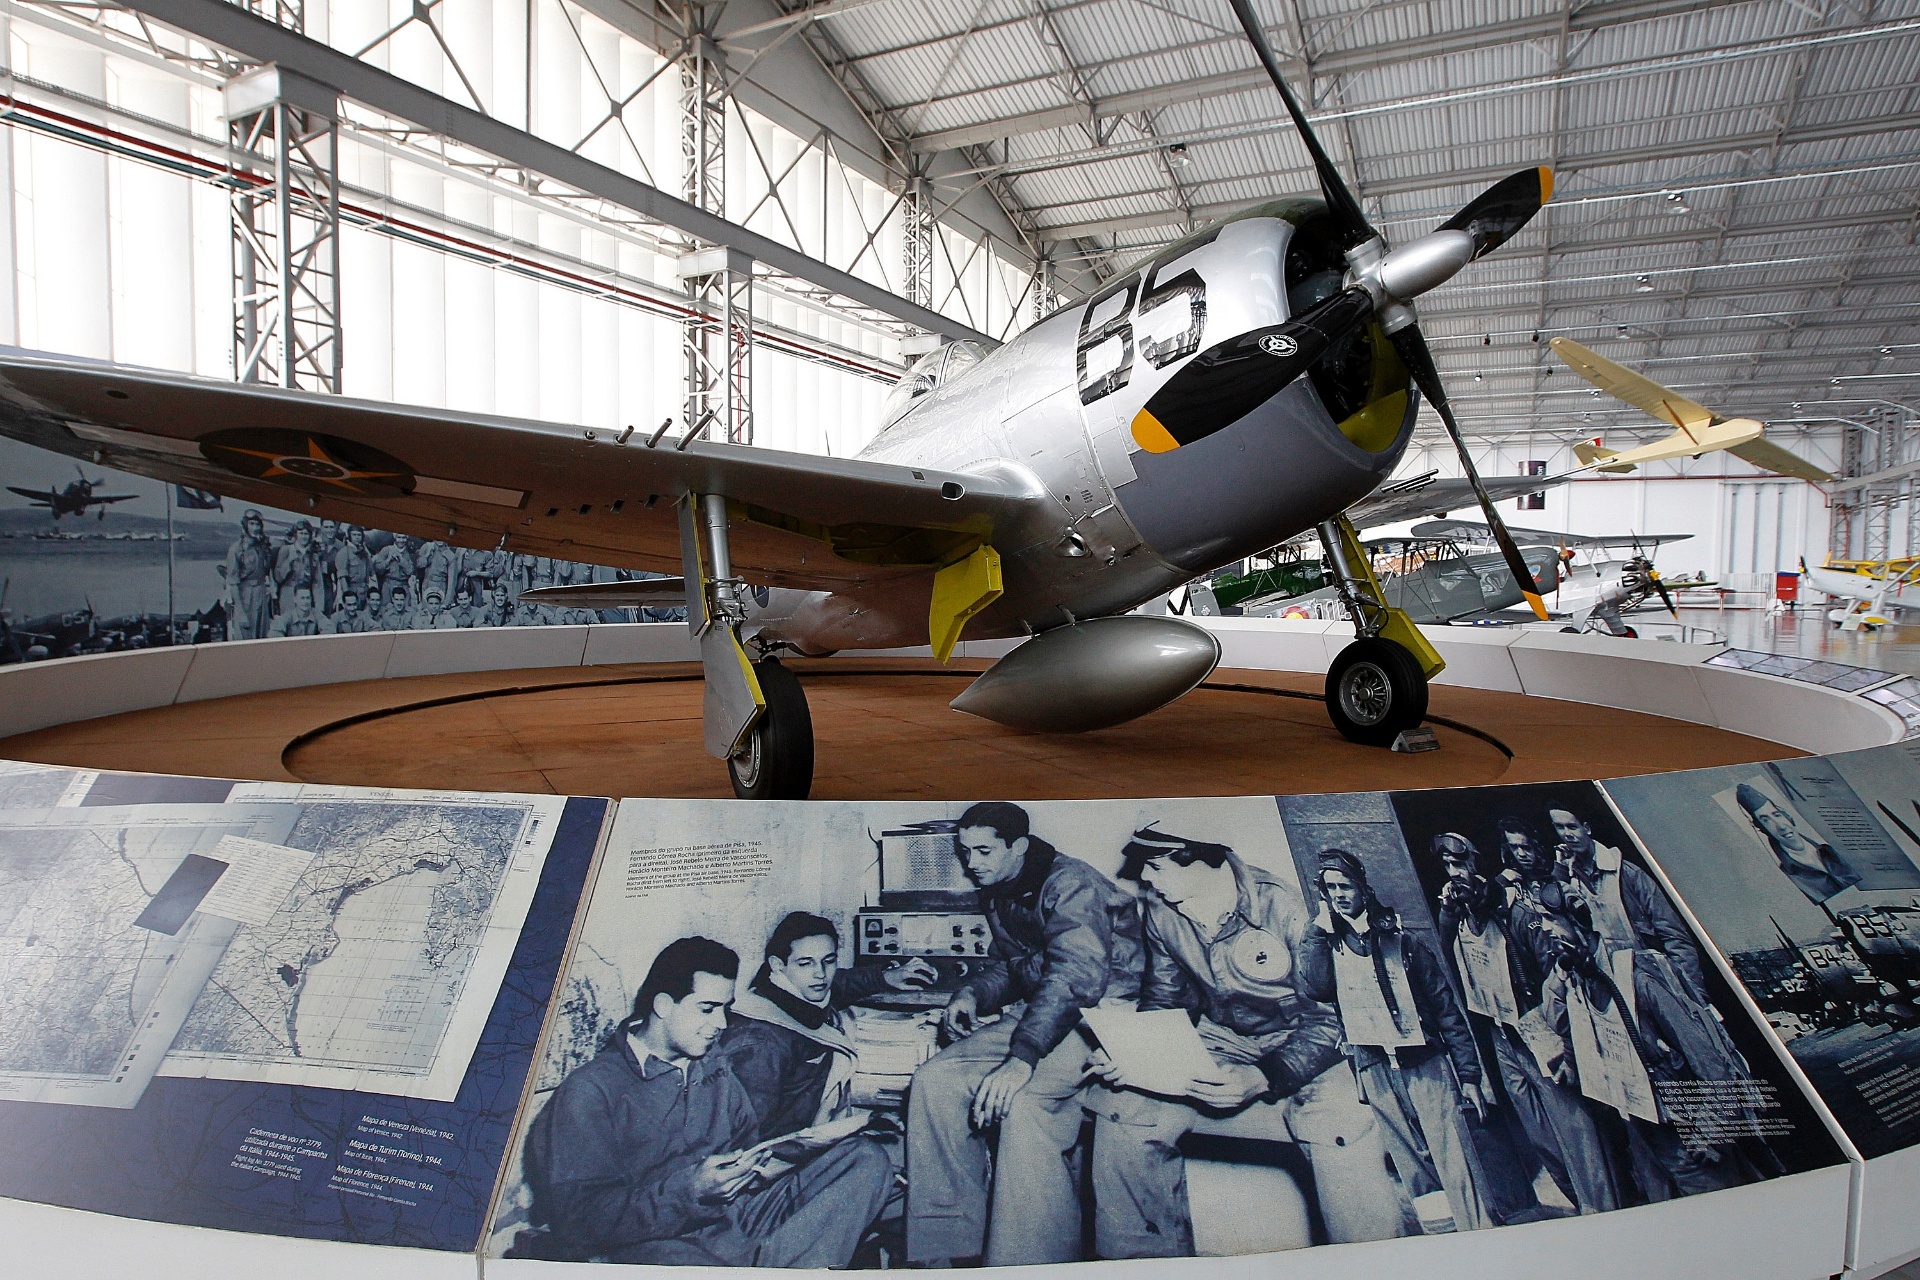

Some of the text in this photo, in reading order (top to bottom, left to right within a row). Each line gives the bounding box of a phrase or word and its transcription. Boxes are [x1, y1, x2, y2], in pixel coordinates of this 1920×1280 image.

[1808, 948, 1841, 968] B4
[362, 1115, 378, 1125] Mapa
[380, 1118, 387, 1126] de
[388, 1120, 409, 1130] Veneza
[250, 1128, 279, 1139] Caderneta
[240, 1144, 247, 1152] da
[245, 1137, 268, 1146] utilizada
[269, 1141, 291, 1151] durante
[296, 1147, 328, 1159] Campanha
[349, 1140, 368, 1150] Mapa
[369, 1143, 378, 1151] de
[379, 1145, 397, 1156] Turim
[425, 1156, 442, 1165] 1944.
[336, 1165, 354, 1175] Mapa
[354, 1168, 362, 1176] de
[363, 1170, 389, 1183] Florença
[418, 1182, 433, 1192] 1944.
